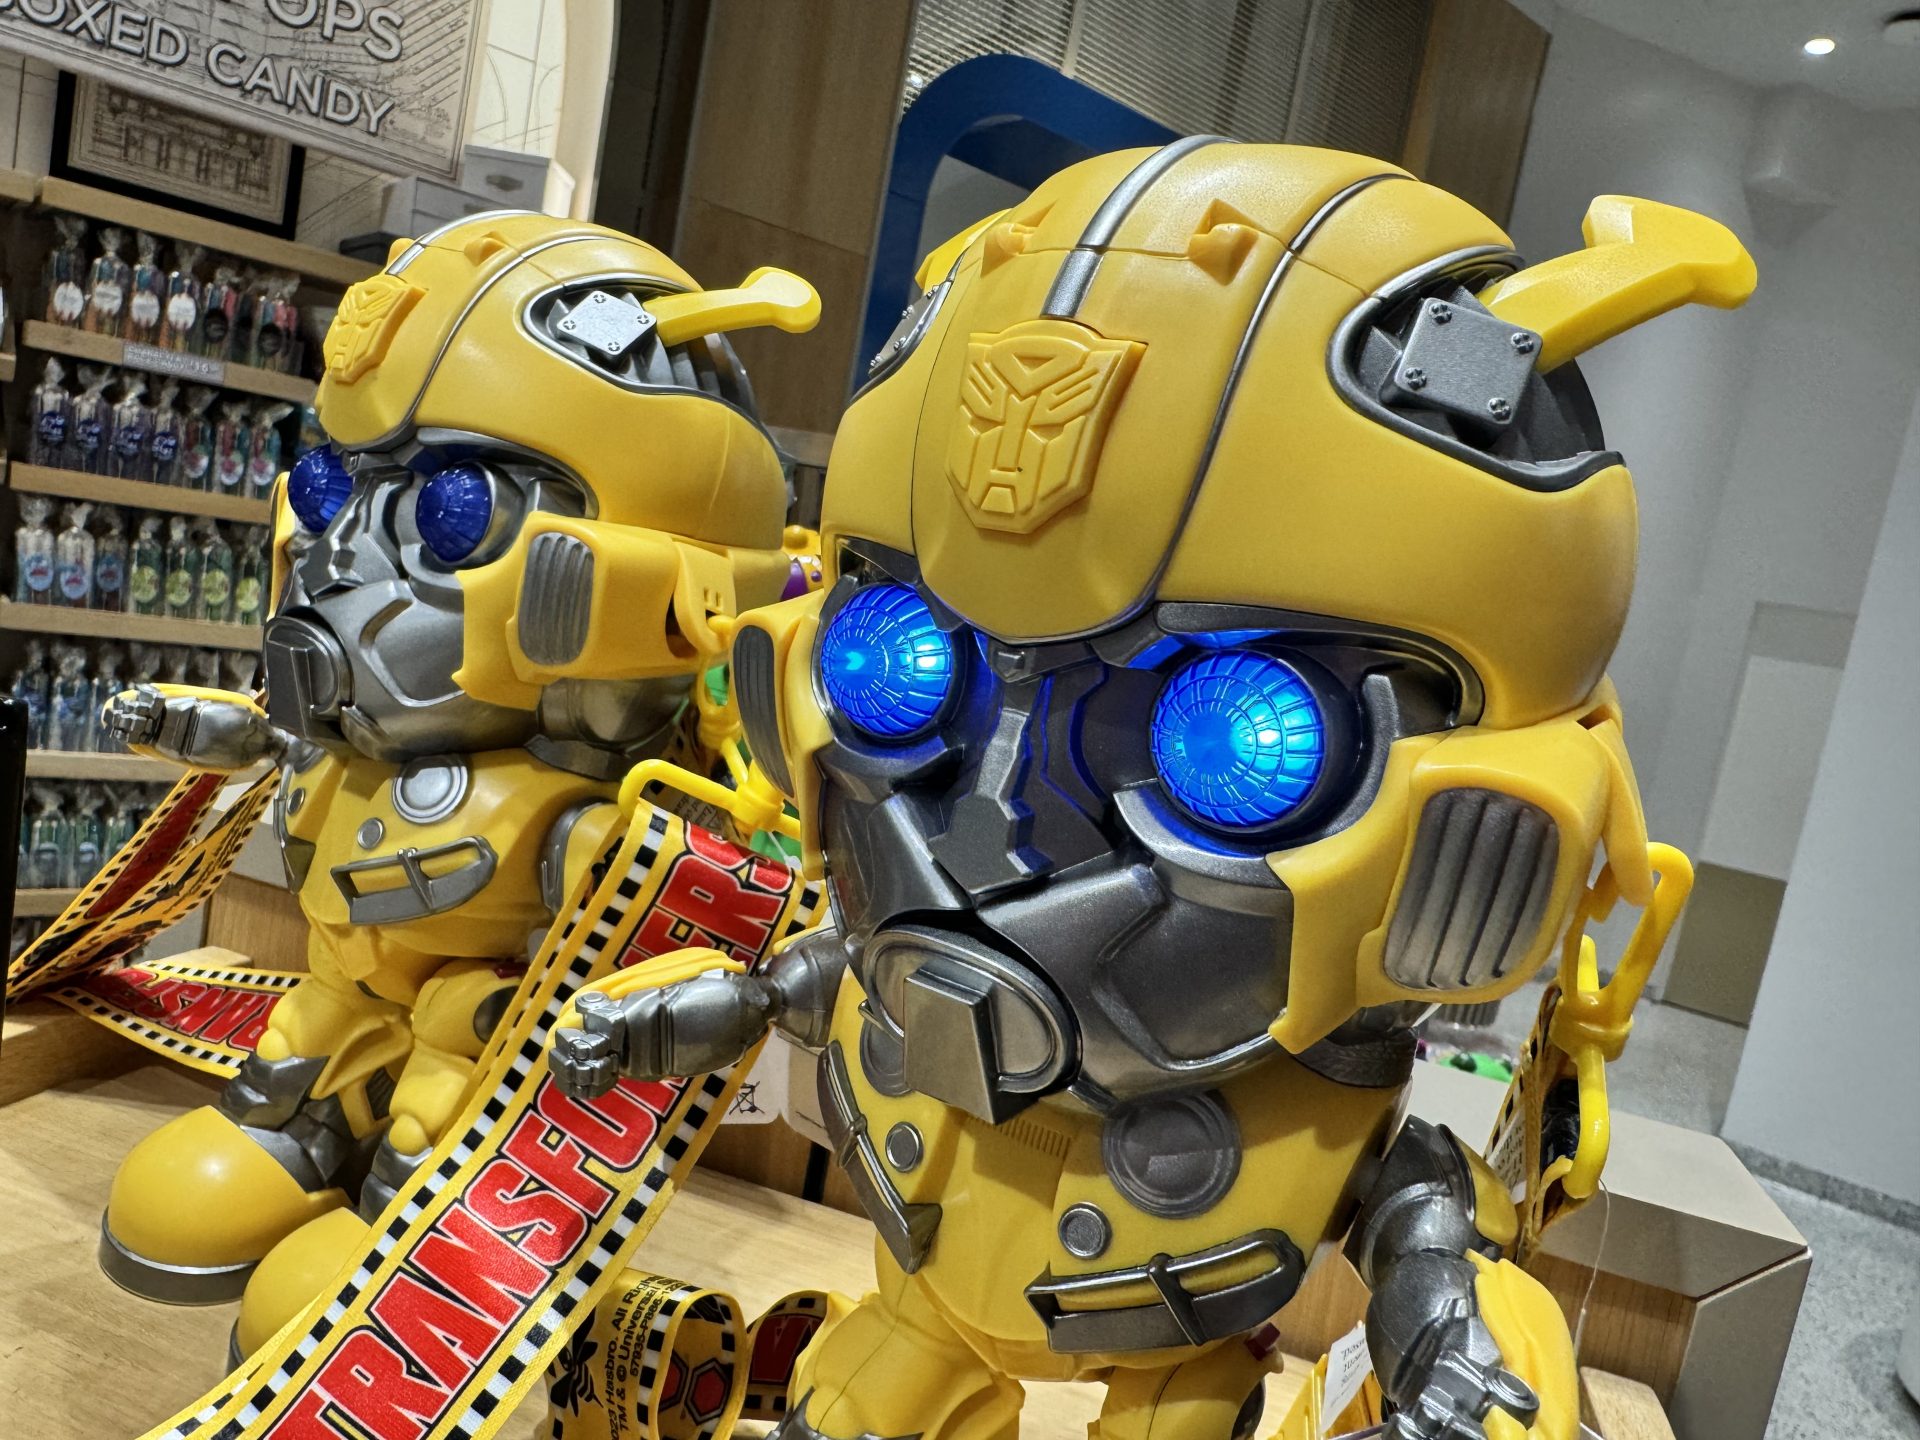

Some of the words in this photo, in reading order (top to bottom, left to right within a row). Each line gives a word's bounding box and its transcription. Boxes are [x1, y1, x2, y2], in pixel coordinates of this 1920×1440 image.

[0, 0, 190, 66] OXED
[205, 41, 396, 135] CANDY
[612, 1307, 628, 1330] All
[618, 1285, 661, 1360] Universal
[616, 1388, 626, 1401] &
[608, 1408, 620, 1440] 023
[617, 1404, 630, 1431] TM
